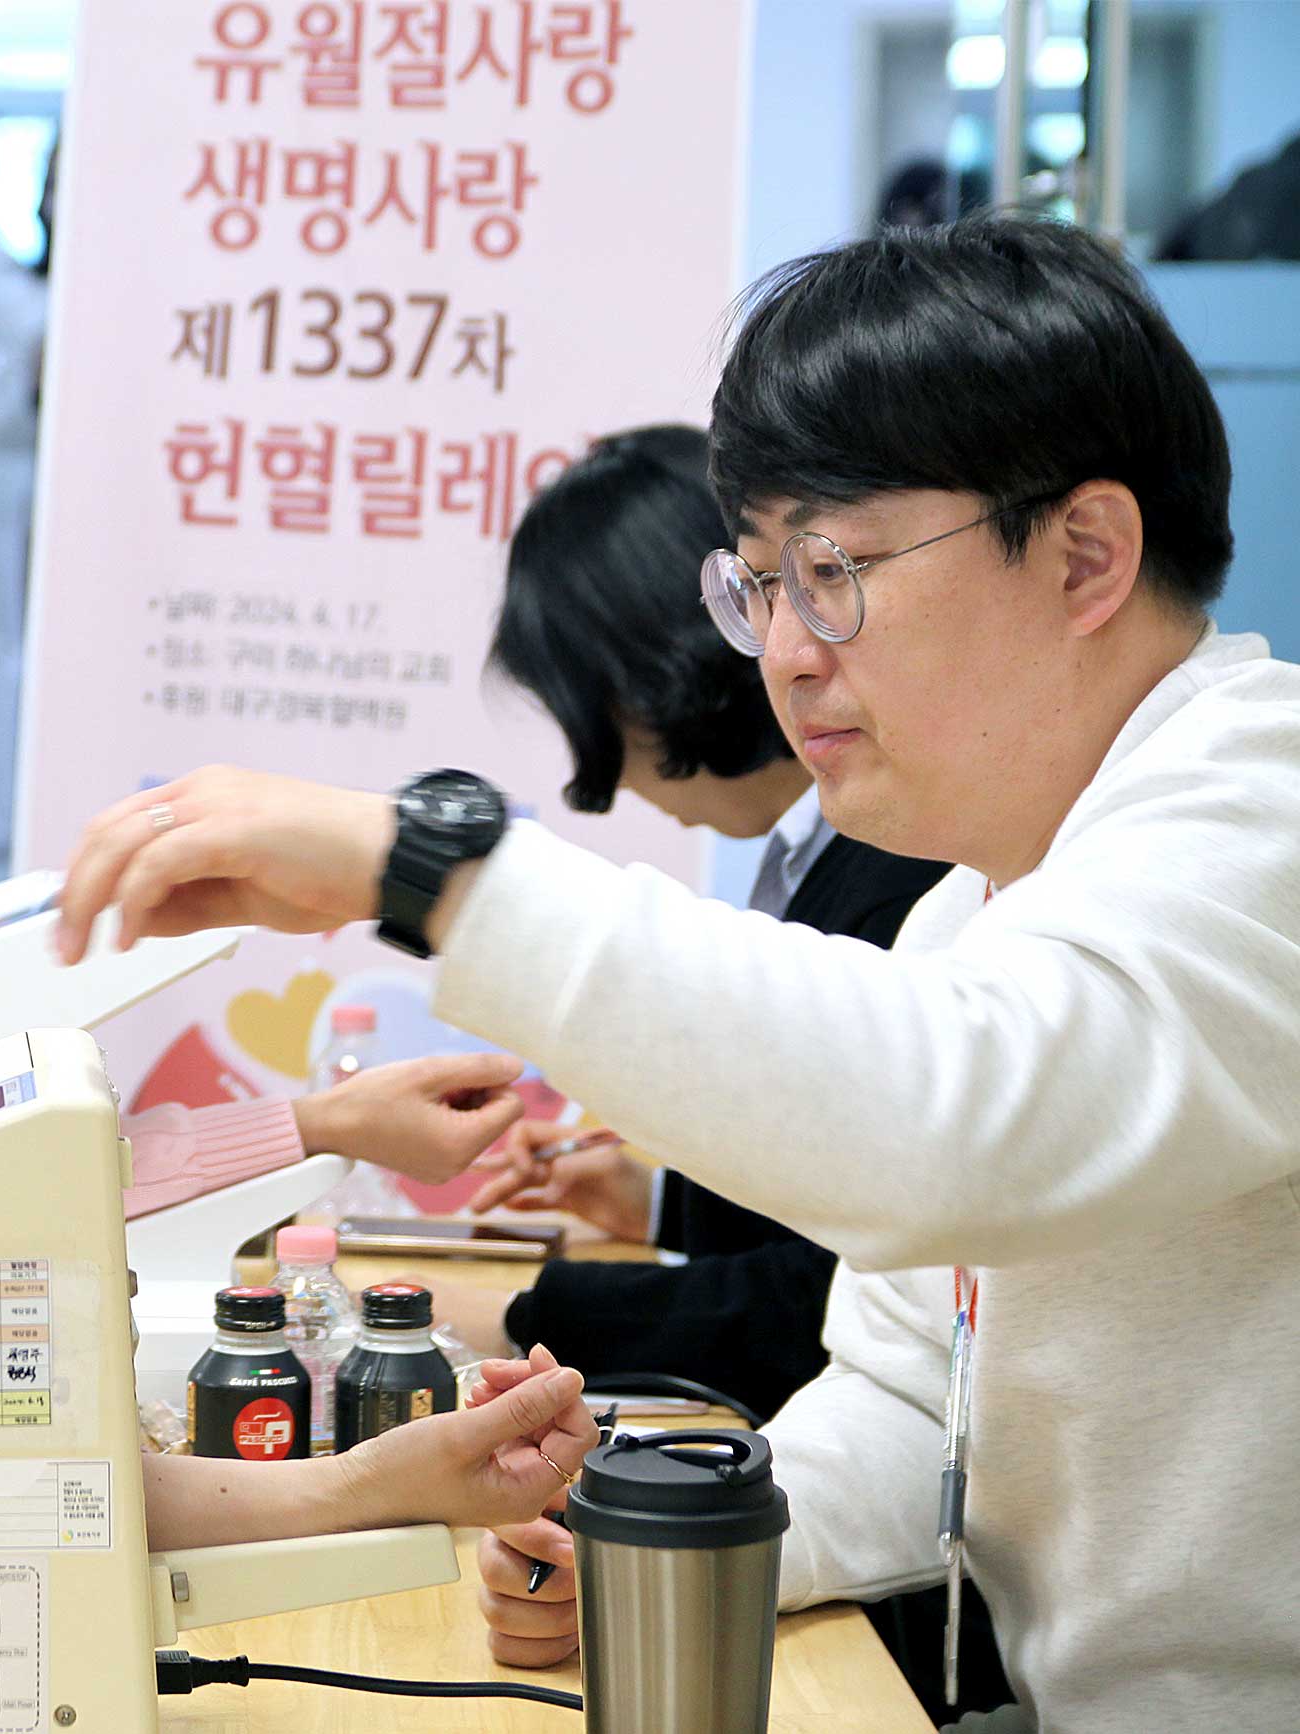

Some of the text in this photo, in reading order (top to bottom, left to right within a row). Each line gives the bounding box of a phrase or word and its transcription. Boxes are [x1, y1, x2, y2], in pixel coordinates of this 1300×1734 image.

[195, 0, 632, 114] 유월절사랑
[184, 140, 539, 259] 생명사랑
[170, 287, 515, 393] 제1337차
